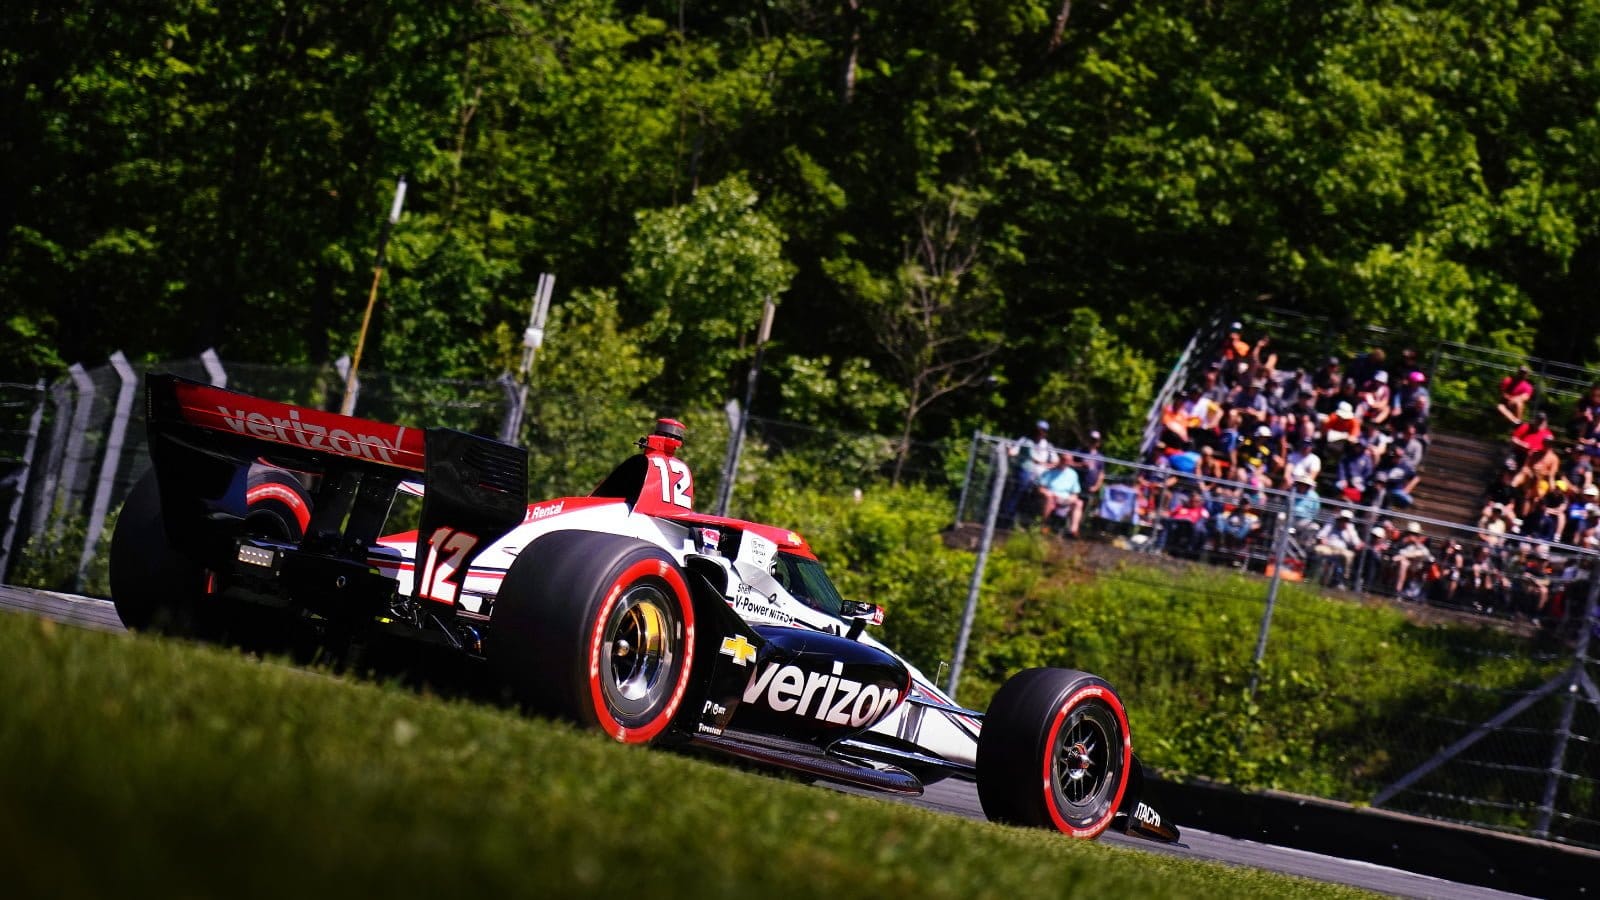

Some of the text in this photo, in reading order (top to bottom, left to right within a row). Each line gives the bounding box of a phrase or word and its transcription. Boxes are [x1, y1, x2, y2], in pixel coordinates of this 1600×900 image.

[217, 405, 393, 463] verizon
[531, 500, 565, 520] Rental
[652, 456, 692, 511] 12
[419, 525, 480, 606] 12
[735, 595, 769, 616] V-Power
[742, 660, 900, 728] verizon
[1133, 801, 1161, 828] ITACHI
